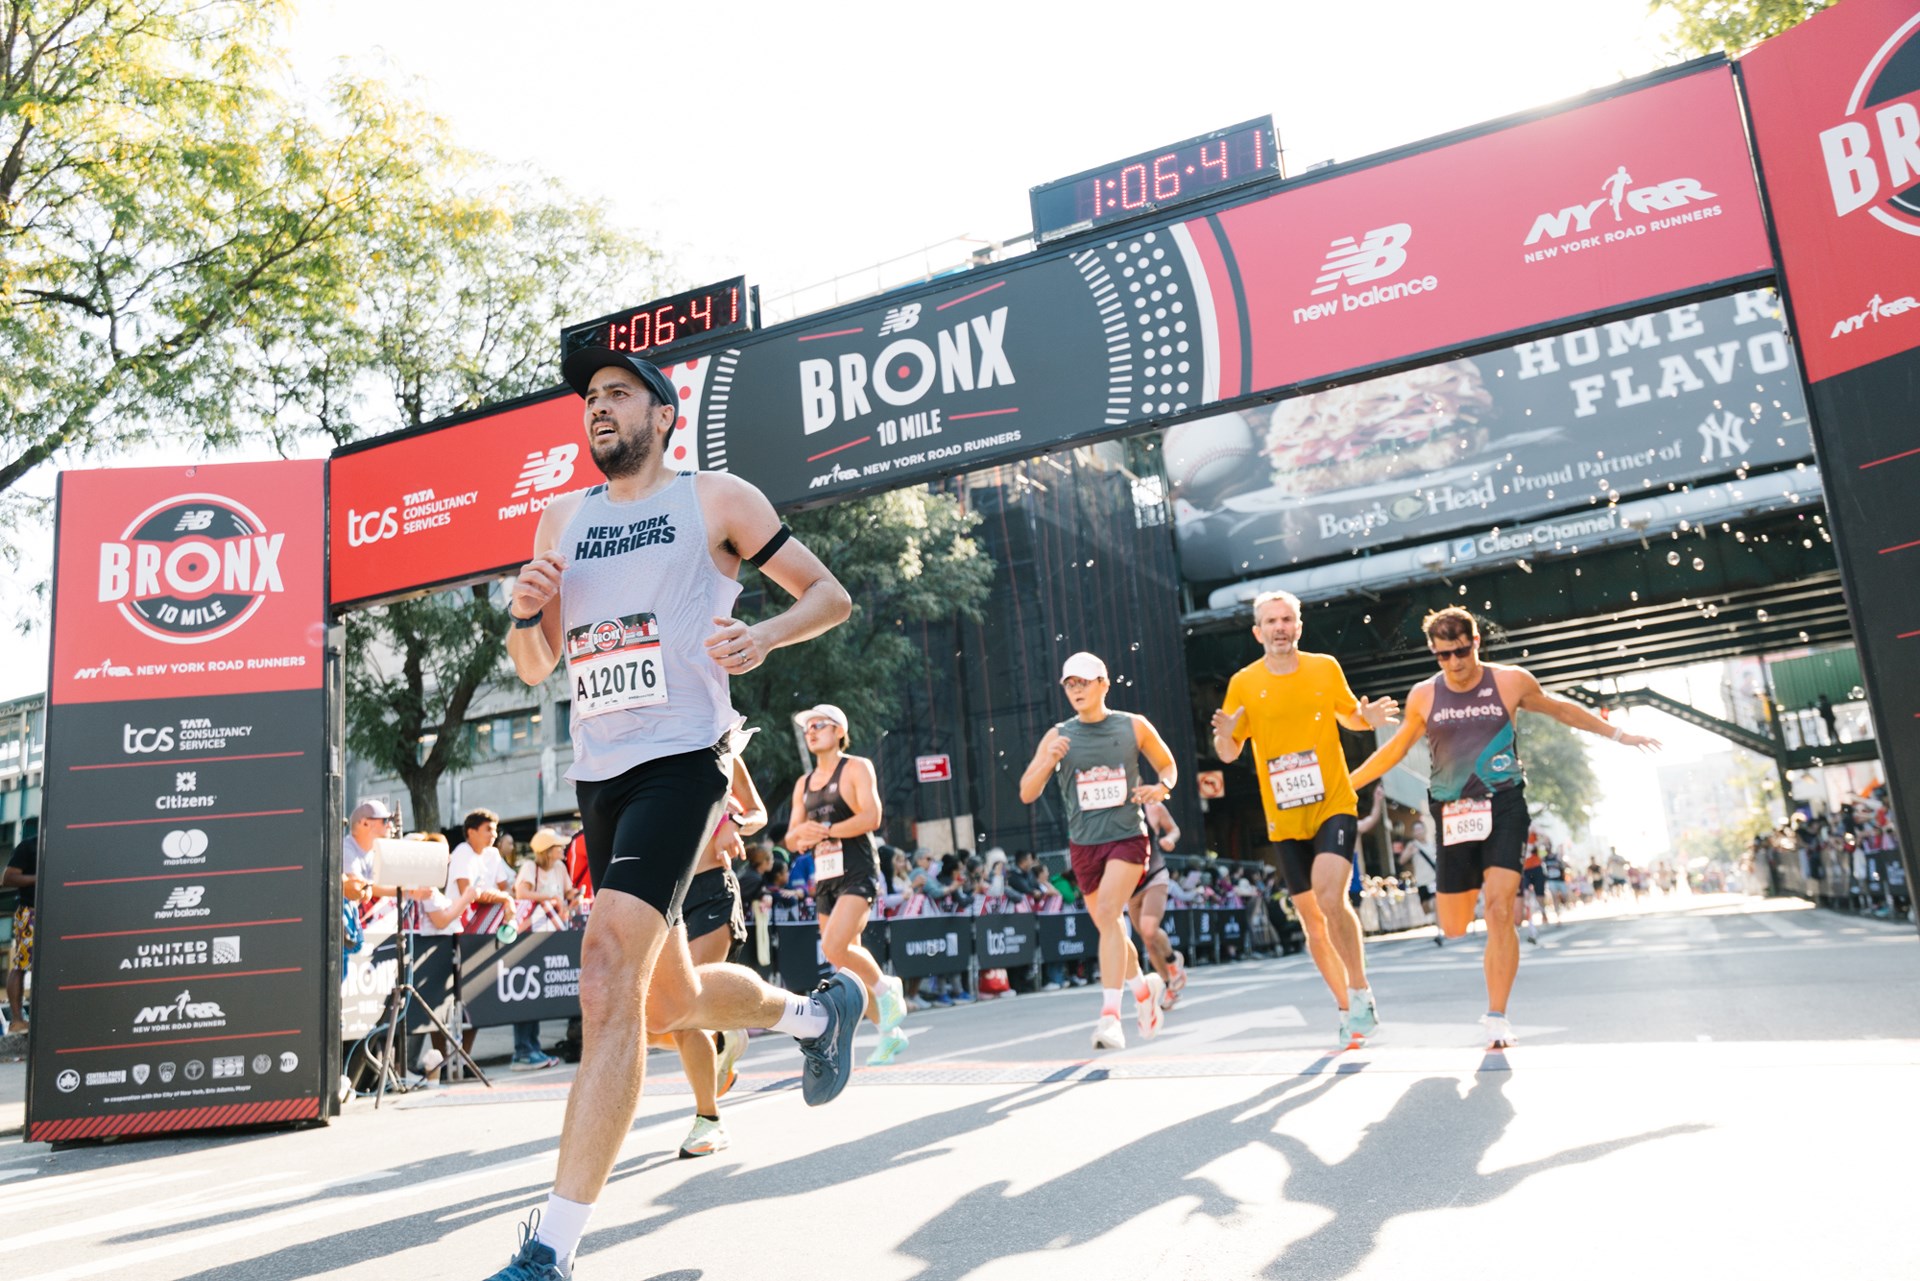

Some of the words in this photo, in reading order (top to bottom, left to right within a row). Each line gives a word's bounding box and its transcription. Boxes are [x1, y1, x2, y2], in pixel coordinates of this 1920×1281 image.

[1524, 247, 1558, 264] NEW
[1561, 236, 1600, 254] YORK
[1604, 225, 1647, 243] ROAD
[1650, 205, 1723, 232] RUNNERS
[1293, 297, 1338, 324] new
[1342, 274, 1438, 313] balance
[1513, 302, 1704, 380] HOME
[799, 306, 1016, 436] BRONX
[1569, 331, 1789, 418] FLAVO
[876, 419, 897, 447] 10
[900, 408, 943, 442] MILE
[863, 461, 891, 476] NEW
[893, 453, 925, 469] YORK
[927, 445, 962, 461] ROAD
[964, 430, 1022, 453] RUNNERS
[1425, 476, 1497, 516] Head
[1512, 464, 1573, 494] Proud
[1576, 451, 1654, 480] Partner
[1659, 439, 1683, 461] of
[403, 488, 435, 506] TATA
[403, 490, 478, 521] CONSULTANCY
[498, 502, 529, 520] new
[348, 506, 398, 547] tcs
[403, 512, 451, 535] SERVICES
[586, 526, 624, 540] NEW
[628, 514, 670, 534] YORK
[575, 526, 676, 561] HARRIERS
[98, 533, 286, 603] BRONX
[156, 603, 179, 624] 10
[180, 600, 227, 626] MILE
[136, 664, 167, 676] NEW
[170, 661, 205, 673] YORK
[208, 659, 244, 672] ROAD
[247, 656, 306, 669] RUNNERS
[180, 718, 212, 729] TATA
[1433, 703, 1503, 723] elitefeats
[123, 723, 174, 754] tcs
[179, 726, 252, 740] CONSULTANCY
[179, 738, 226, 751] SERVICES
[1286, 773, 1315, 792] 5461
[155, 795, 215, 810] Citizens
[1094, 786, 1120, 801] 3185
[1457, 818, 1484, 834] 6896
[163, 855, 206, 866] mastercard
[154, 909, 173, 919] new
[174, 907, 210, 919] balance
[137, 941, 207, 957] UNITED
[119, 952, 207, 970] AIRLINES
[543, 955, 570, 969] TATA
[497, 959, 541, 1003] tcs
[133, 1026, 150, 1034] NEW
[151, 1024, 170, 1032] YORK
[171, 1022, 192, 1030] ROAD
[193, 1020, 226, 1028] RUNNERS
